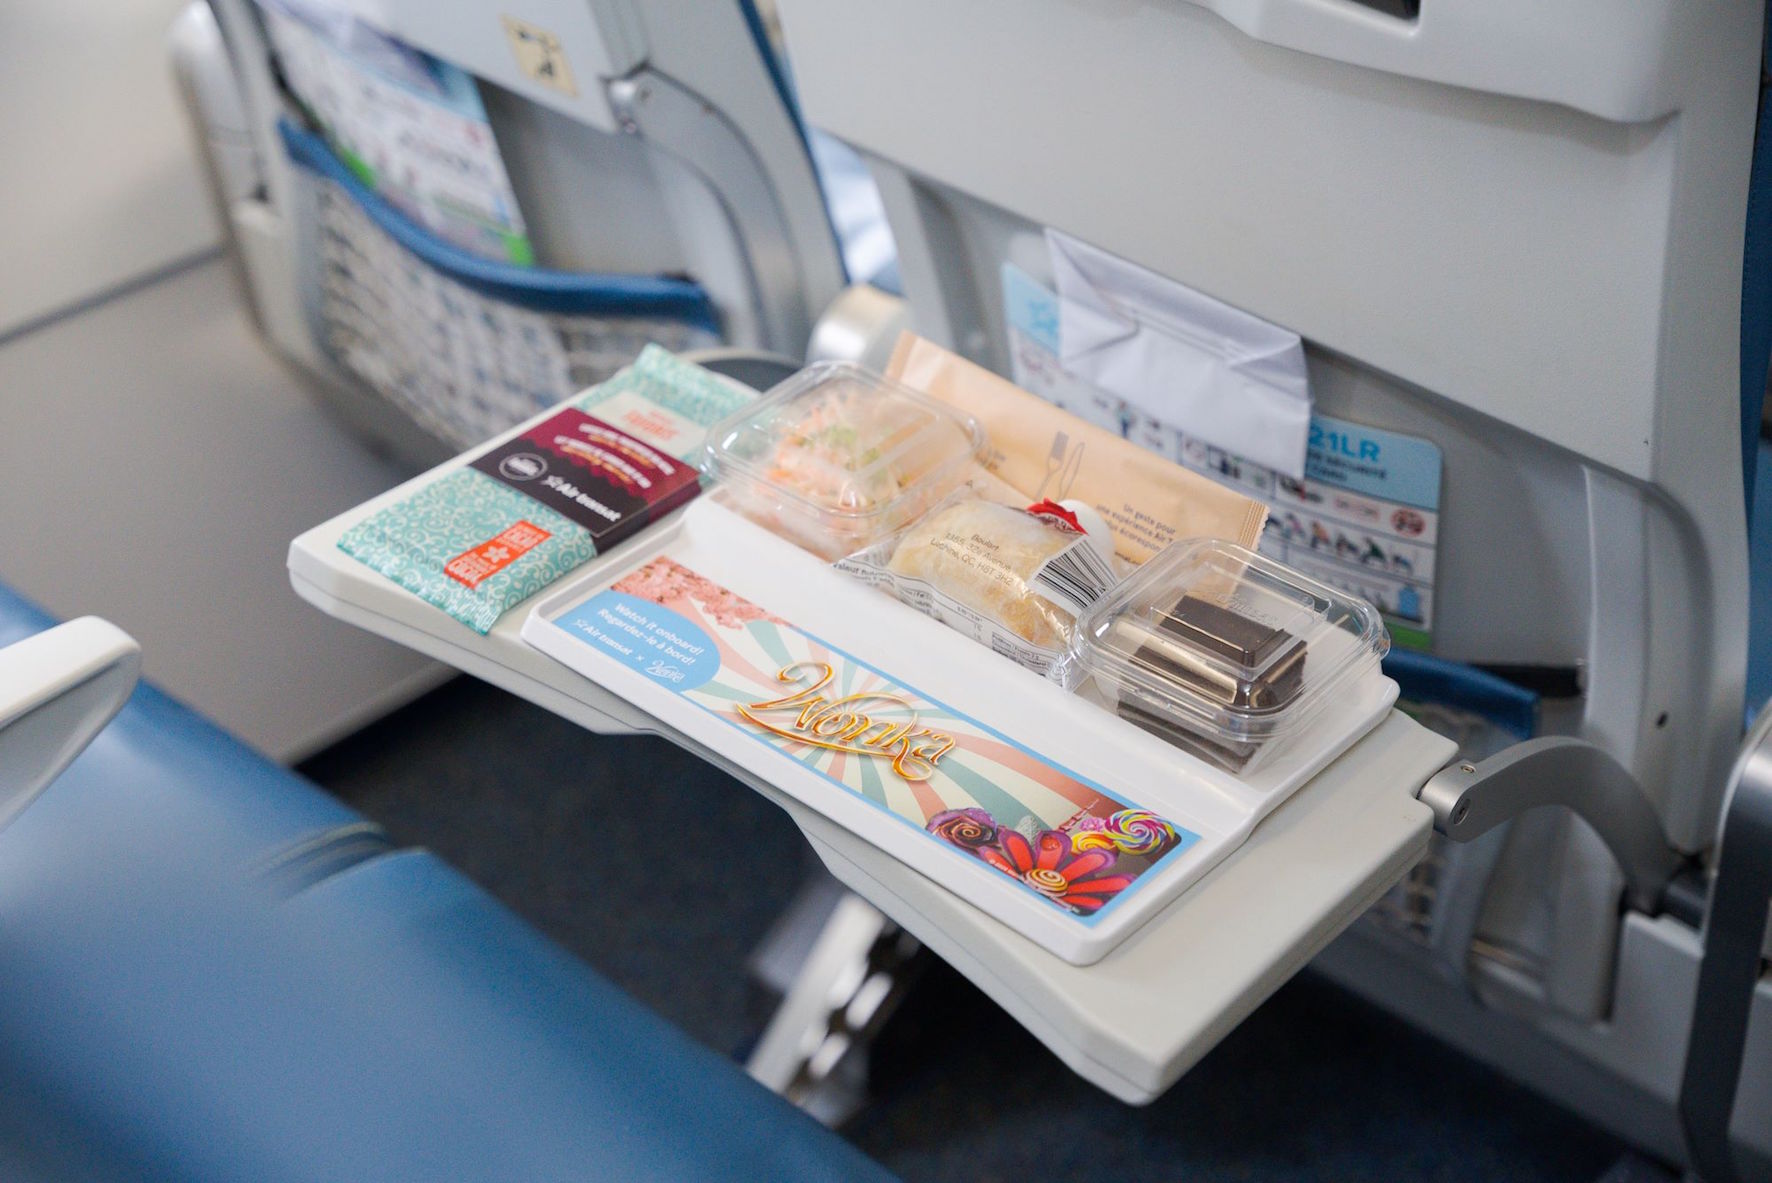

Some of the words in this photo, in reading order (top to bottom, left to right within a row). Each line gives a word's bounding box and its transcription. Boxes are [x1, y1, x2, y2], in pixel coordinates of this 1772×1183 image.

[1112, 512, 1153, 536] expérience
[1135, 511, 1155, 525] geste
[1155, 522, 1176, 535] pour
[582, 624, 602, 638] Air
[599, 634, 634, 656] transat
[598, 608, 657, 646] Regardez-le
[656, 641, 666, 651] à
[663, 645, 697, 666] bord!
[614, 602, 646, 625] Watch
[646, 619, 657, 631] it
[656, 627, 705, 656] onboard!
[735, 662, 957, 781] Wonka
